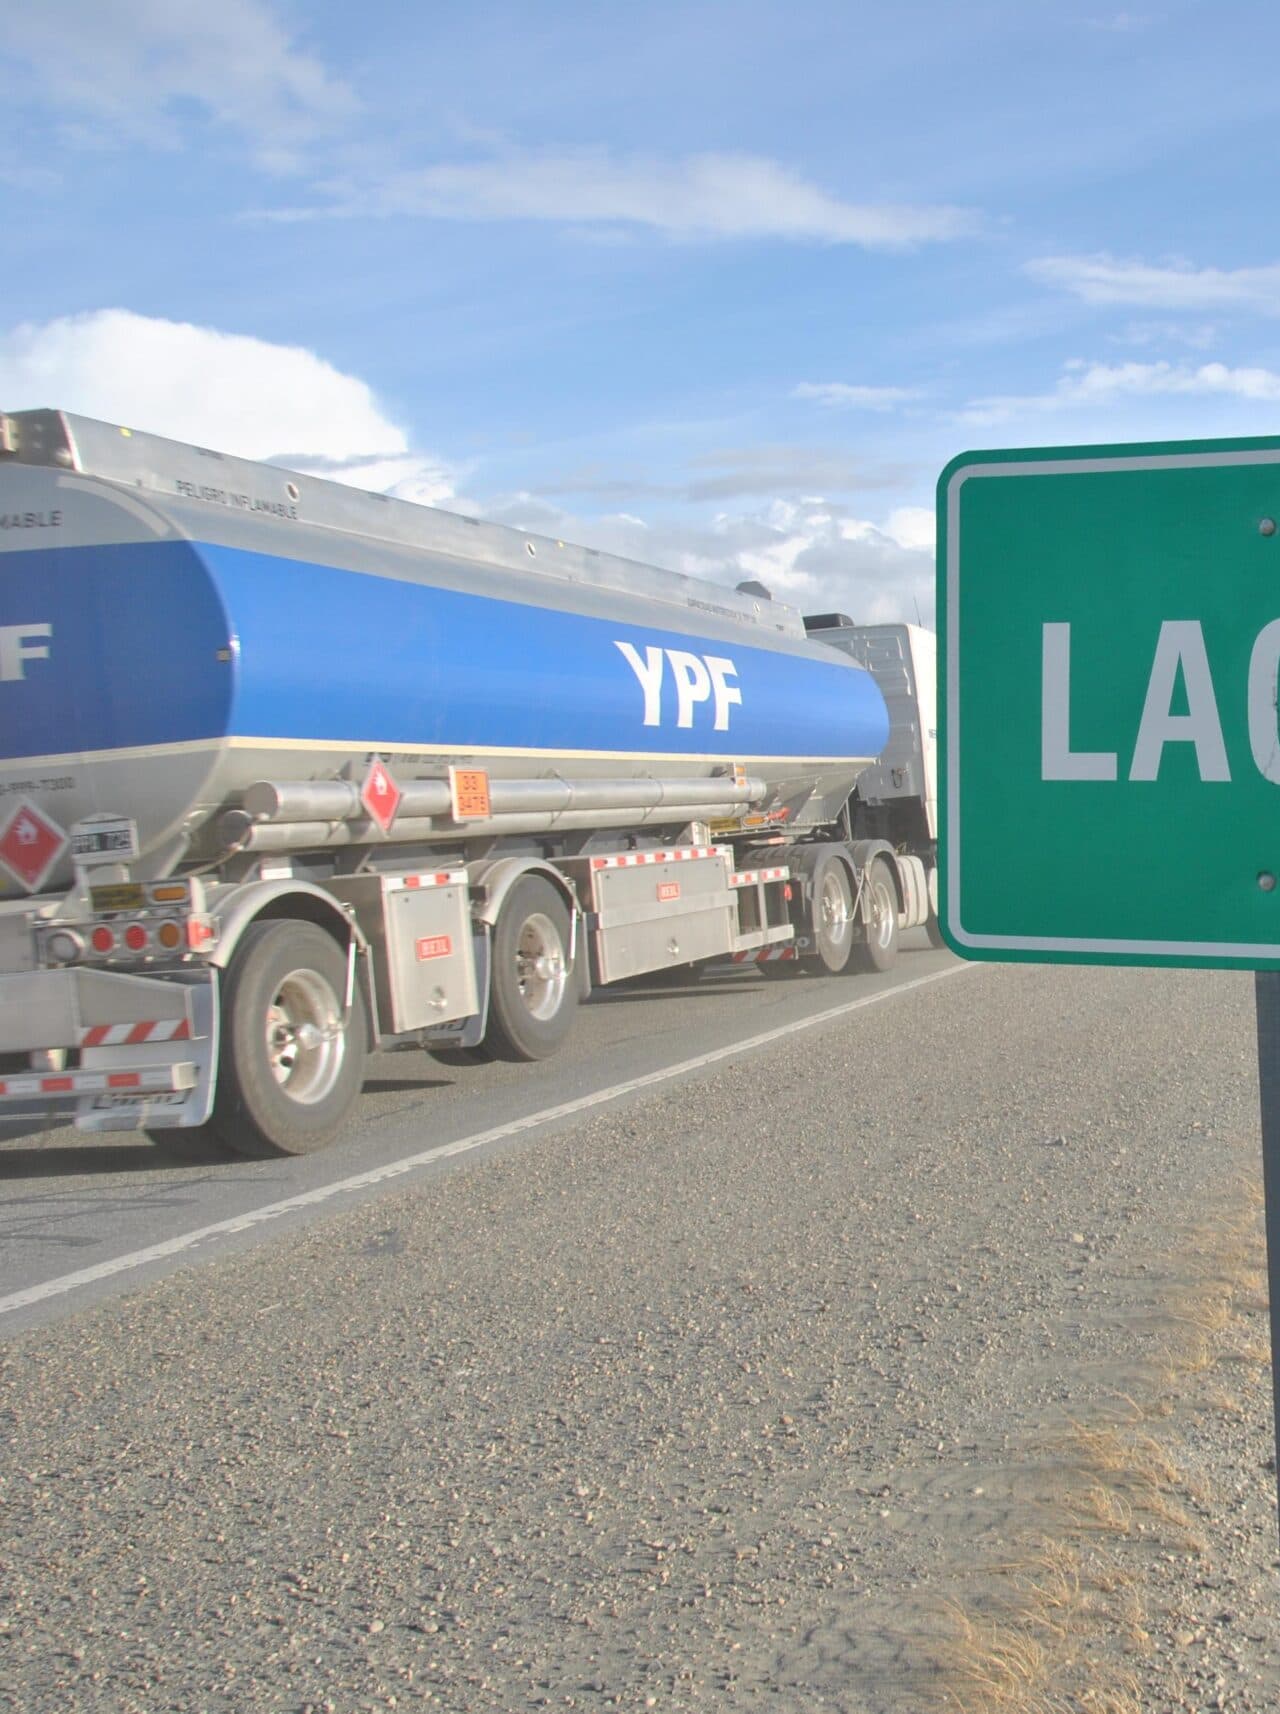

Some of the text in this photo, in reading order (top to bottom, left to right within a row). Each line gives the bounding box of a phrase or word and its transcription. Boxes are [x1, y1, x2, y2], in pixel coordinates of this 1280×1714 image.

[176, 479, 298, 520] PELIGRO INFLAMABLE
[612, 640, 743, 731] YPF
